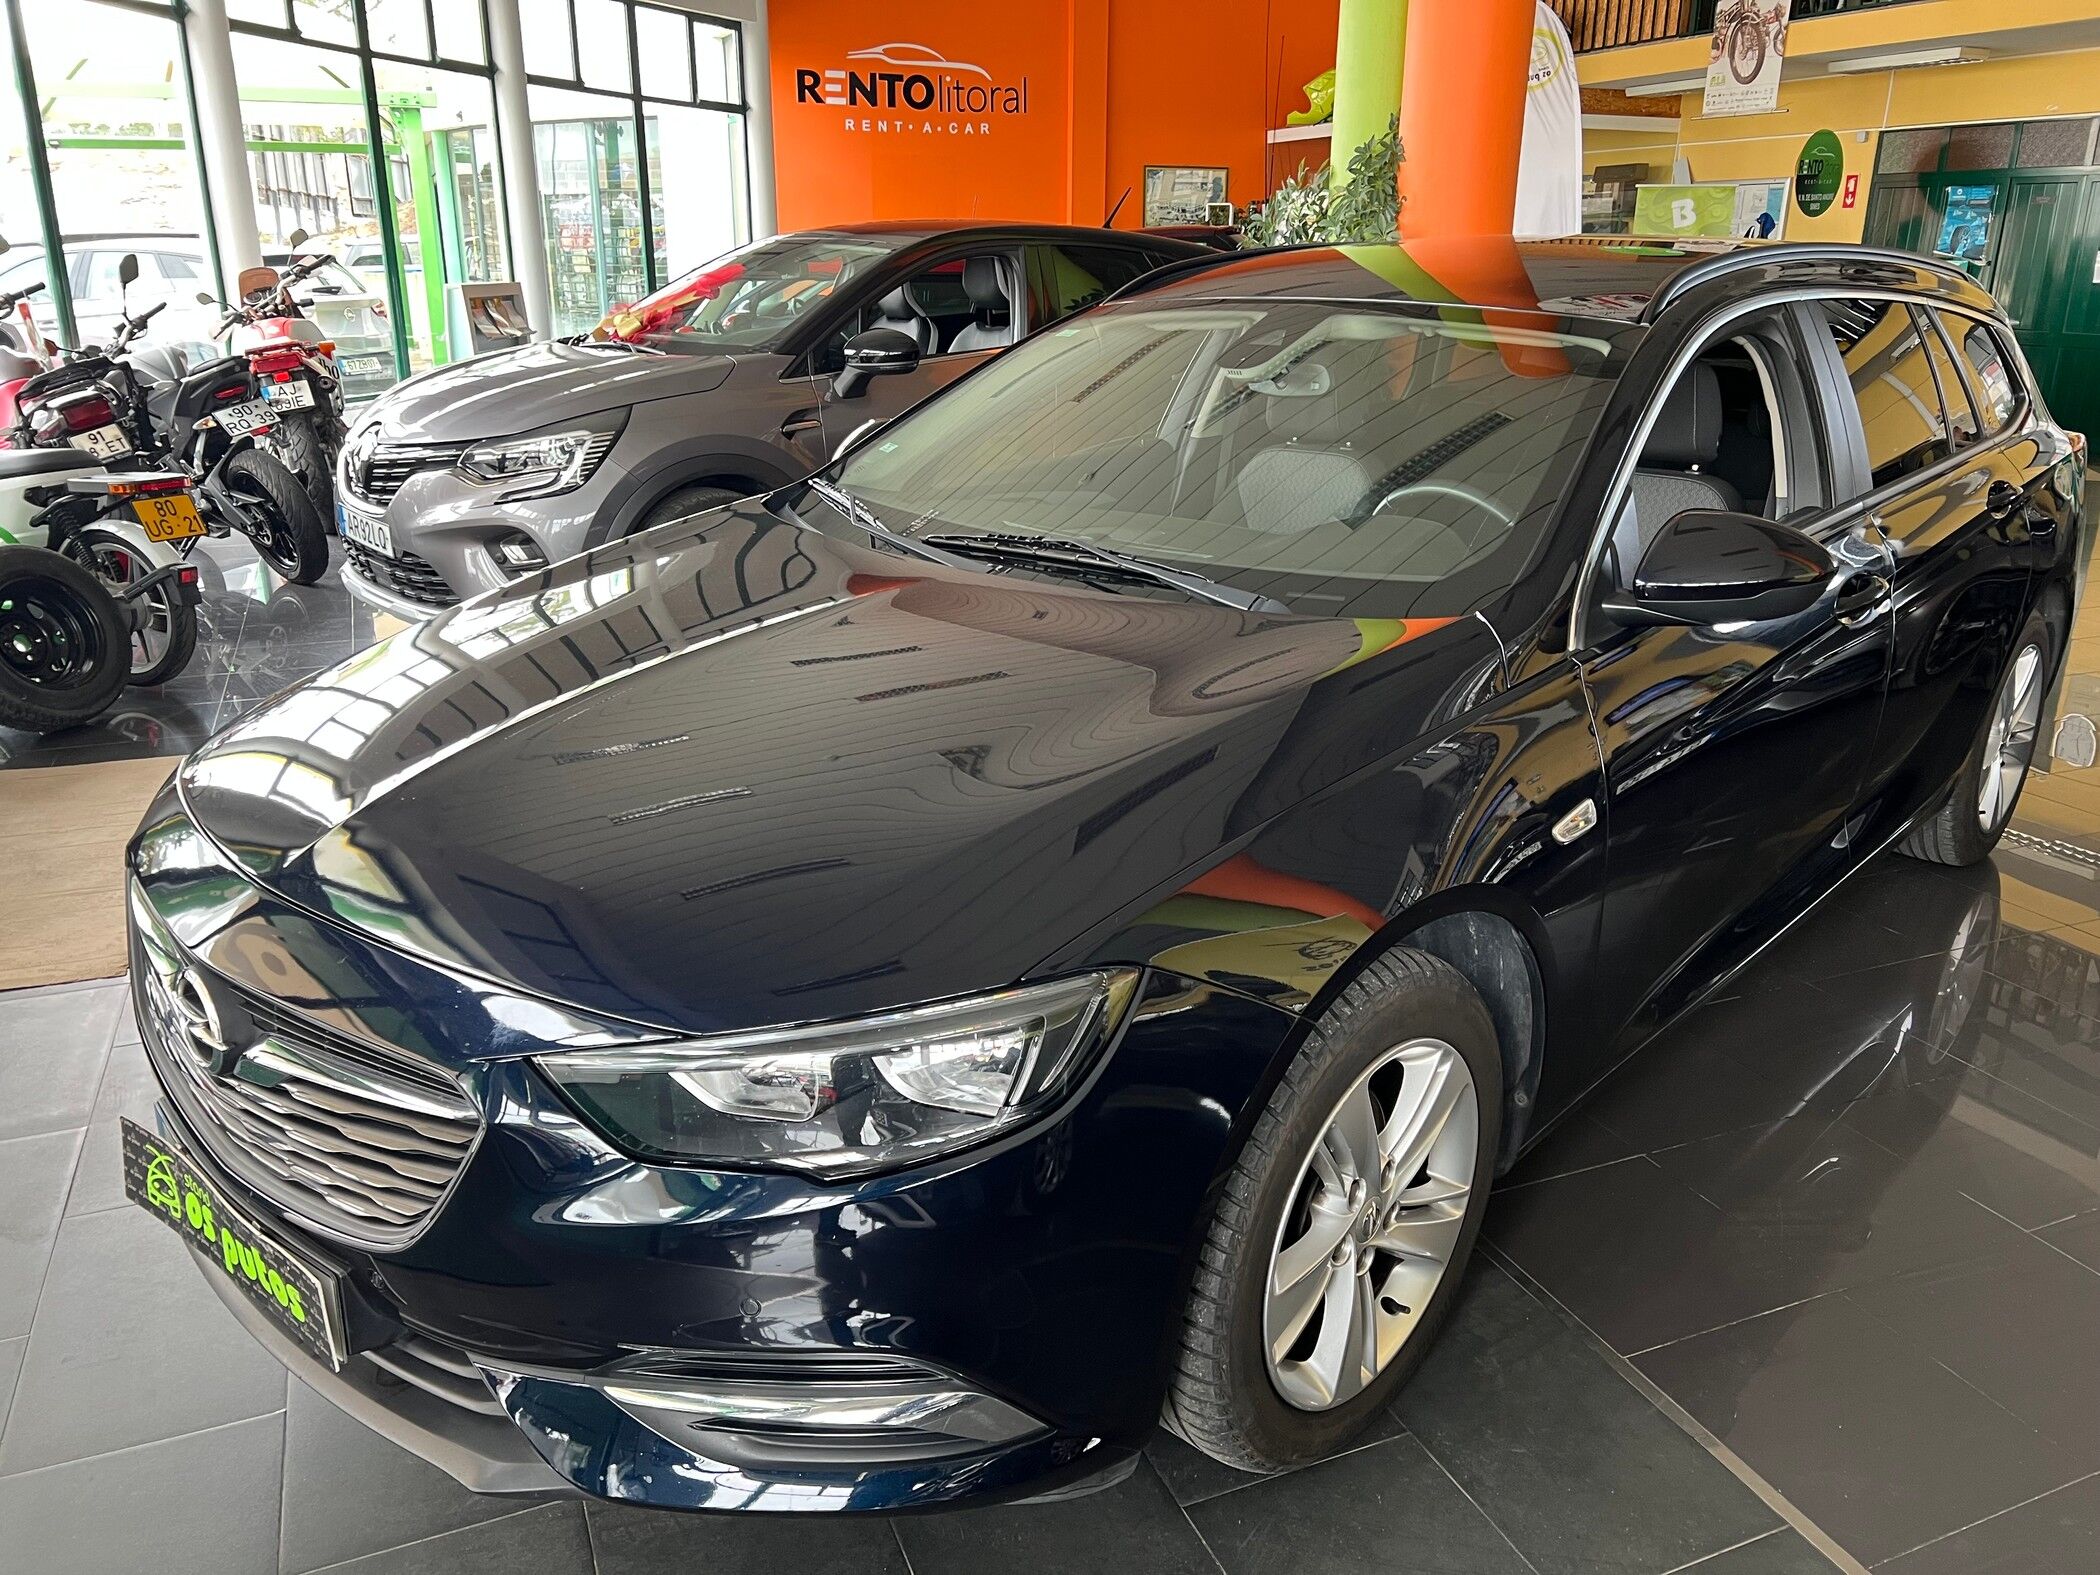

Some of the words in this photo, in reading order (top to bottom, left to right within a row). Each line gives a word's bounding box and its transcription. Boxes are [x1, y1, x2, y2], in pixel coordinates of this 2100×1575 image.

[1671, 198, 1697, 228] B
[277, 383, 298, 397] AJ
[88, 430, 106, 444] 91
[154, 499, 177, 517] 80
[185, 1191, 216, 1243] os
[221, 1227, 306, 1323] putos
